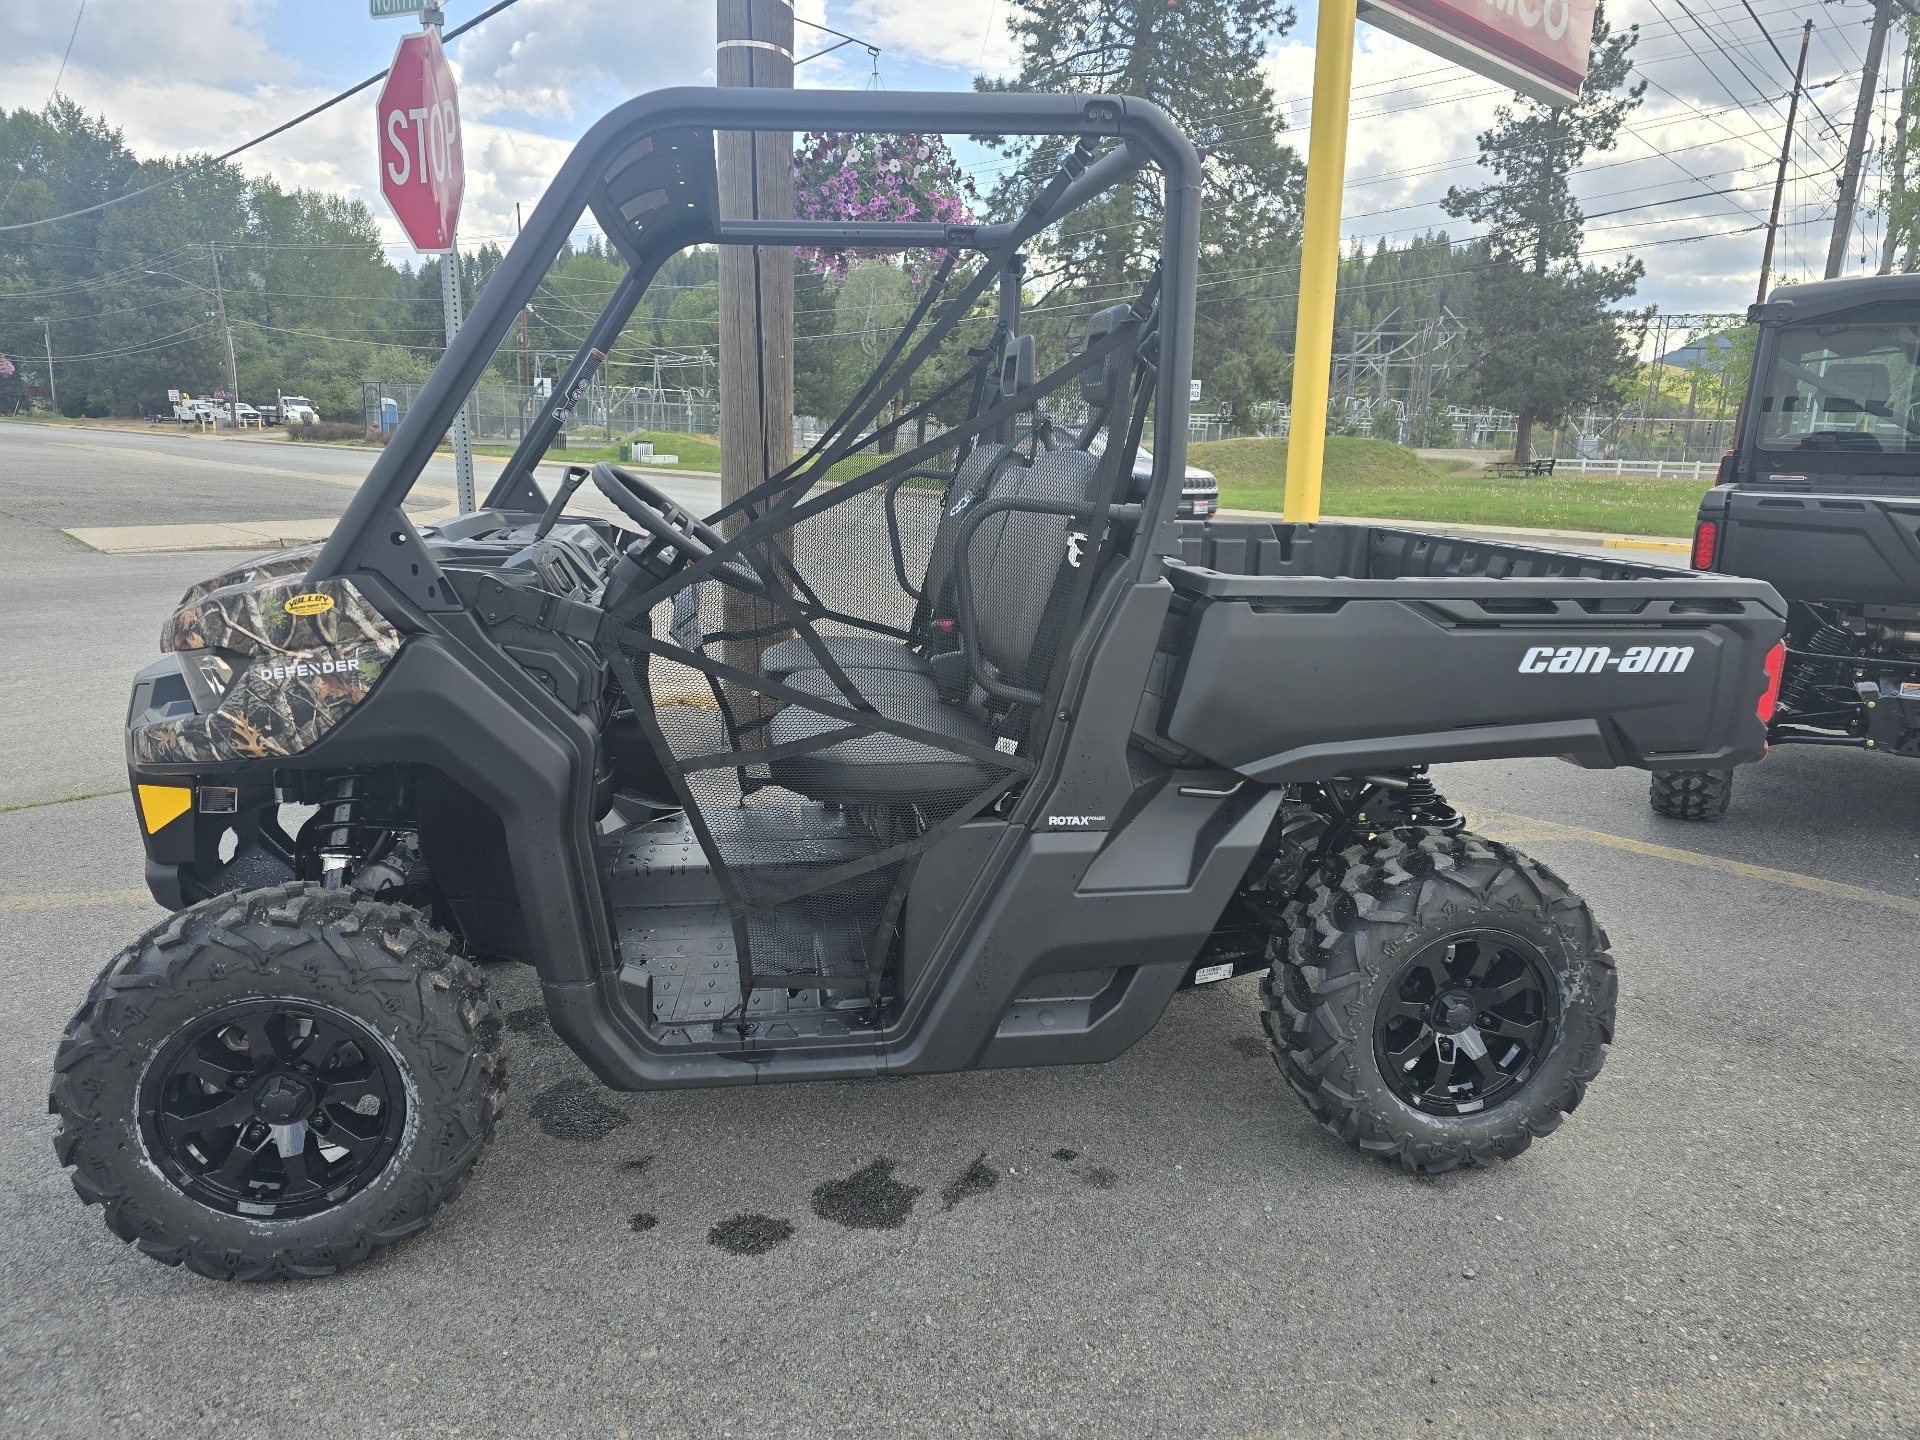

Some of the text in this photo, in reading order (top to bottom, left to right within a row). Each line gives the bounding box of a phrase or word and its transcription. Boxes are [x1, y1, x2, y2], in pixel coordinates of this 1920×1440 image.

[387, 99, 456, 185] STOP
[260, 659, 360, 680] DEFENDER
[1048, 815, 1089, 825] ROTAX
